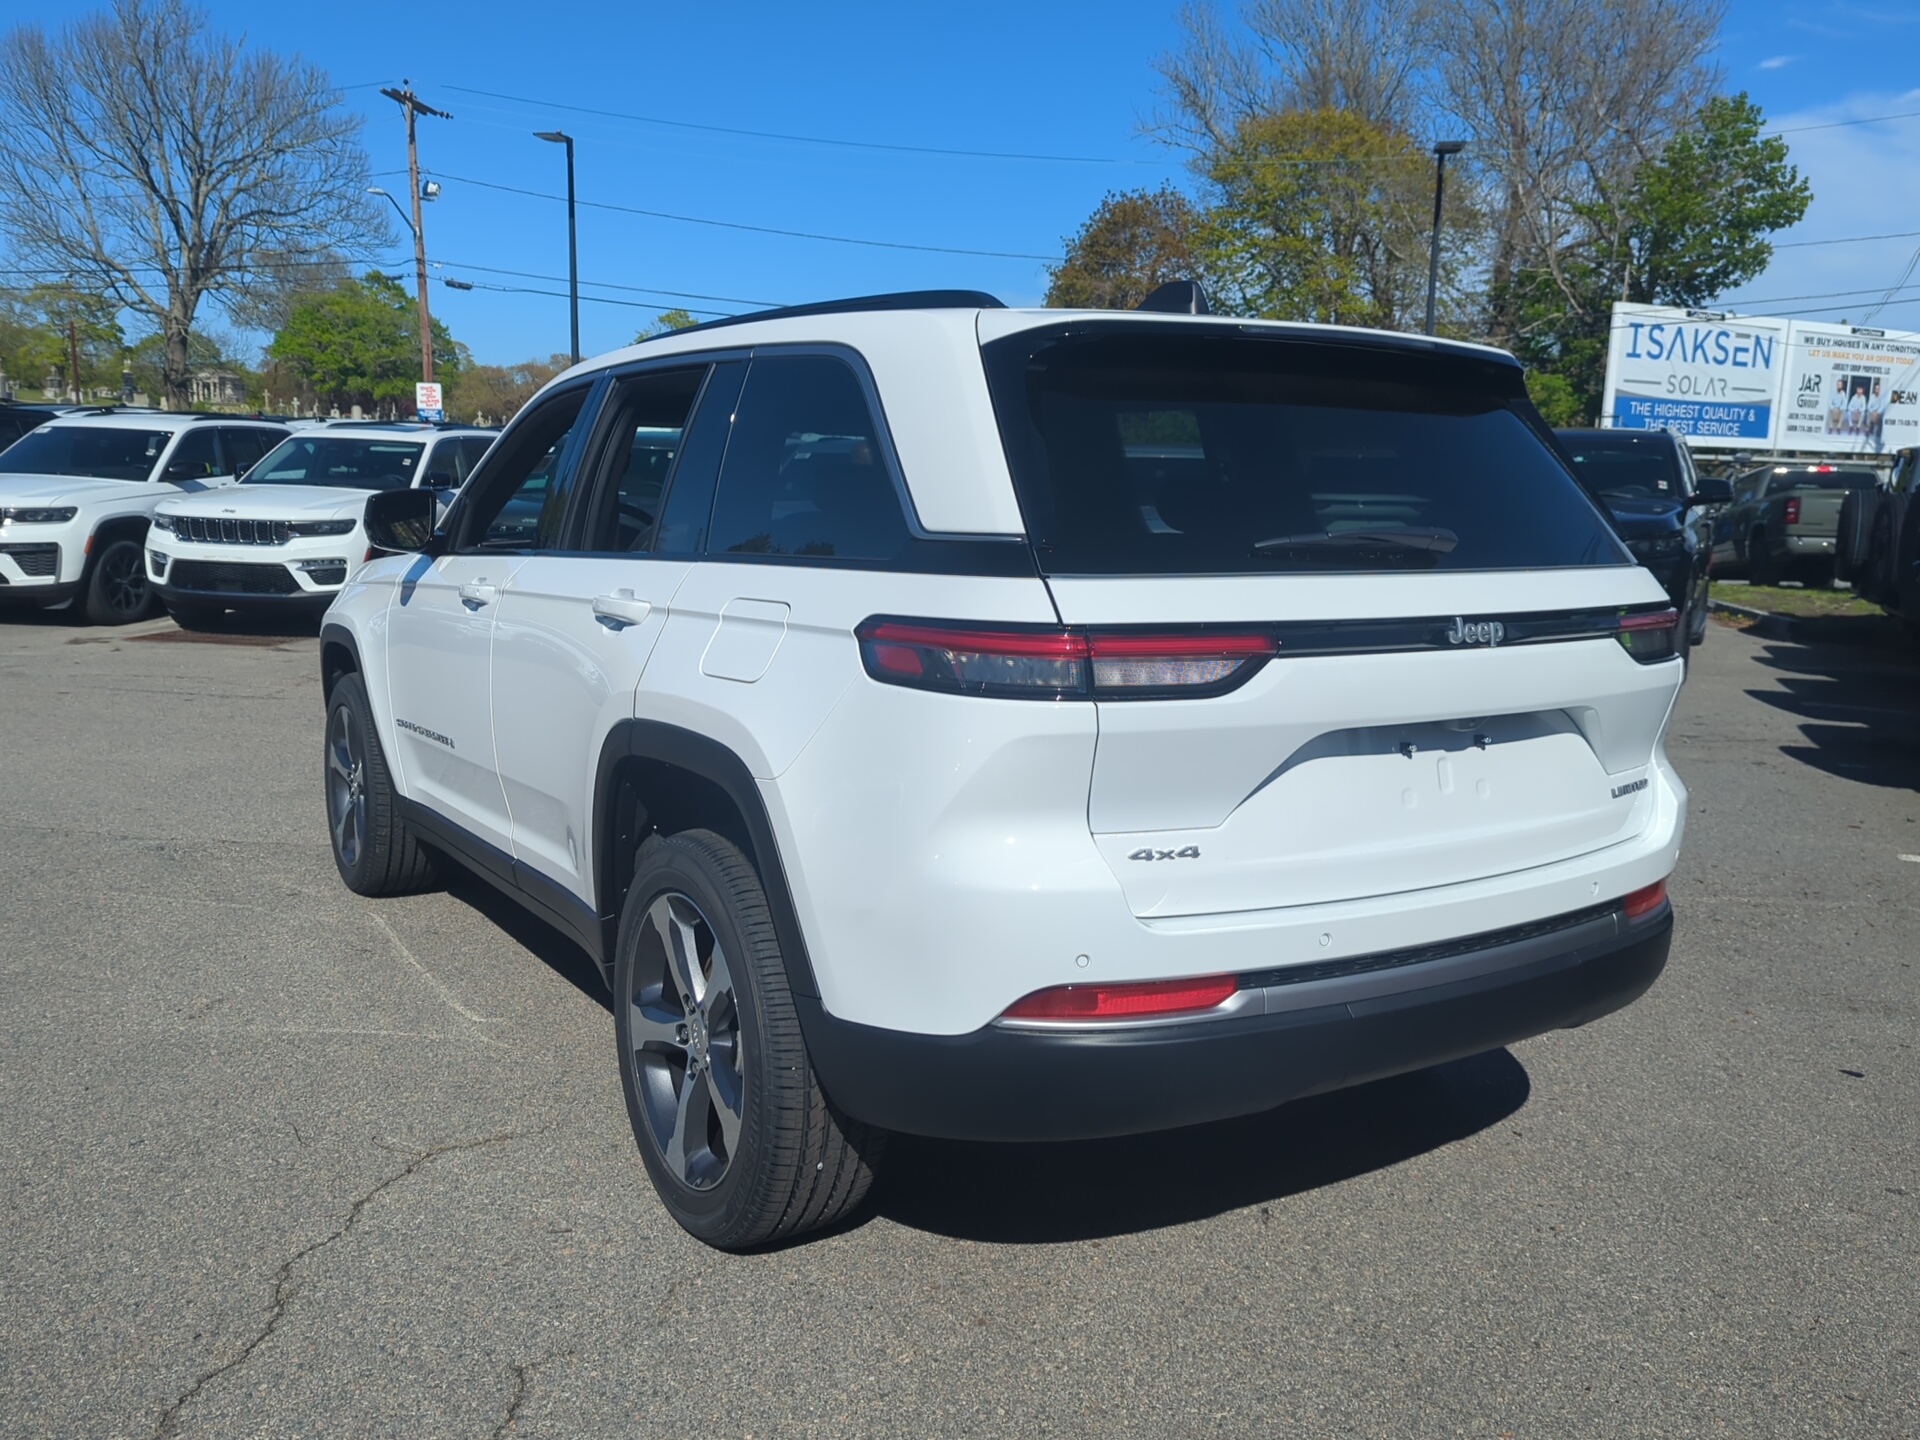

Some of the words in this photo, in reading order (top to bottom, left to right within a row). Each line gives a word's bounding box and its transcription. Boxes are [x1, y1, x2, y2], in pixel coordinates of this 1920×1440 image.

[1626, 322, 1774, 369] ISAKSEN
[1804, 336, 1814, 344] WE
[1816, 337, 1831, 347] BUY
[1833, 339, 1860, 349] HOUSES
[1862, 342, 1869, 350] IN
[1871, 342, 1885, 351] ANY
[1875, 354, 1895, 363] OFFER
[1666, 374, 1728, 397] SOLAR
[1799, 373, 1821, 393] JAR
[1891, 390, 1917, 404] DEAN
[1630, 401, 1651, 416] THE
[1654, 403, 1700, 418] HIGHEST
[1702, 406, 1746, 421] QUALITY
[1748, 409, 1756, 421] &
[1644, 418, 1665, 431] THE
[1697, 421, 1741, 436] SERVICE
[1448, 616, 1504, 648] Jeep
[1126, 845, 1201, 861] 4x4
